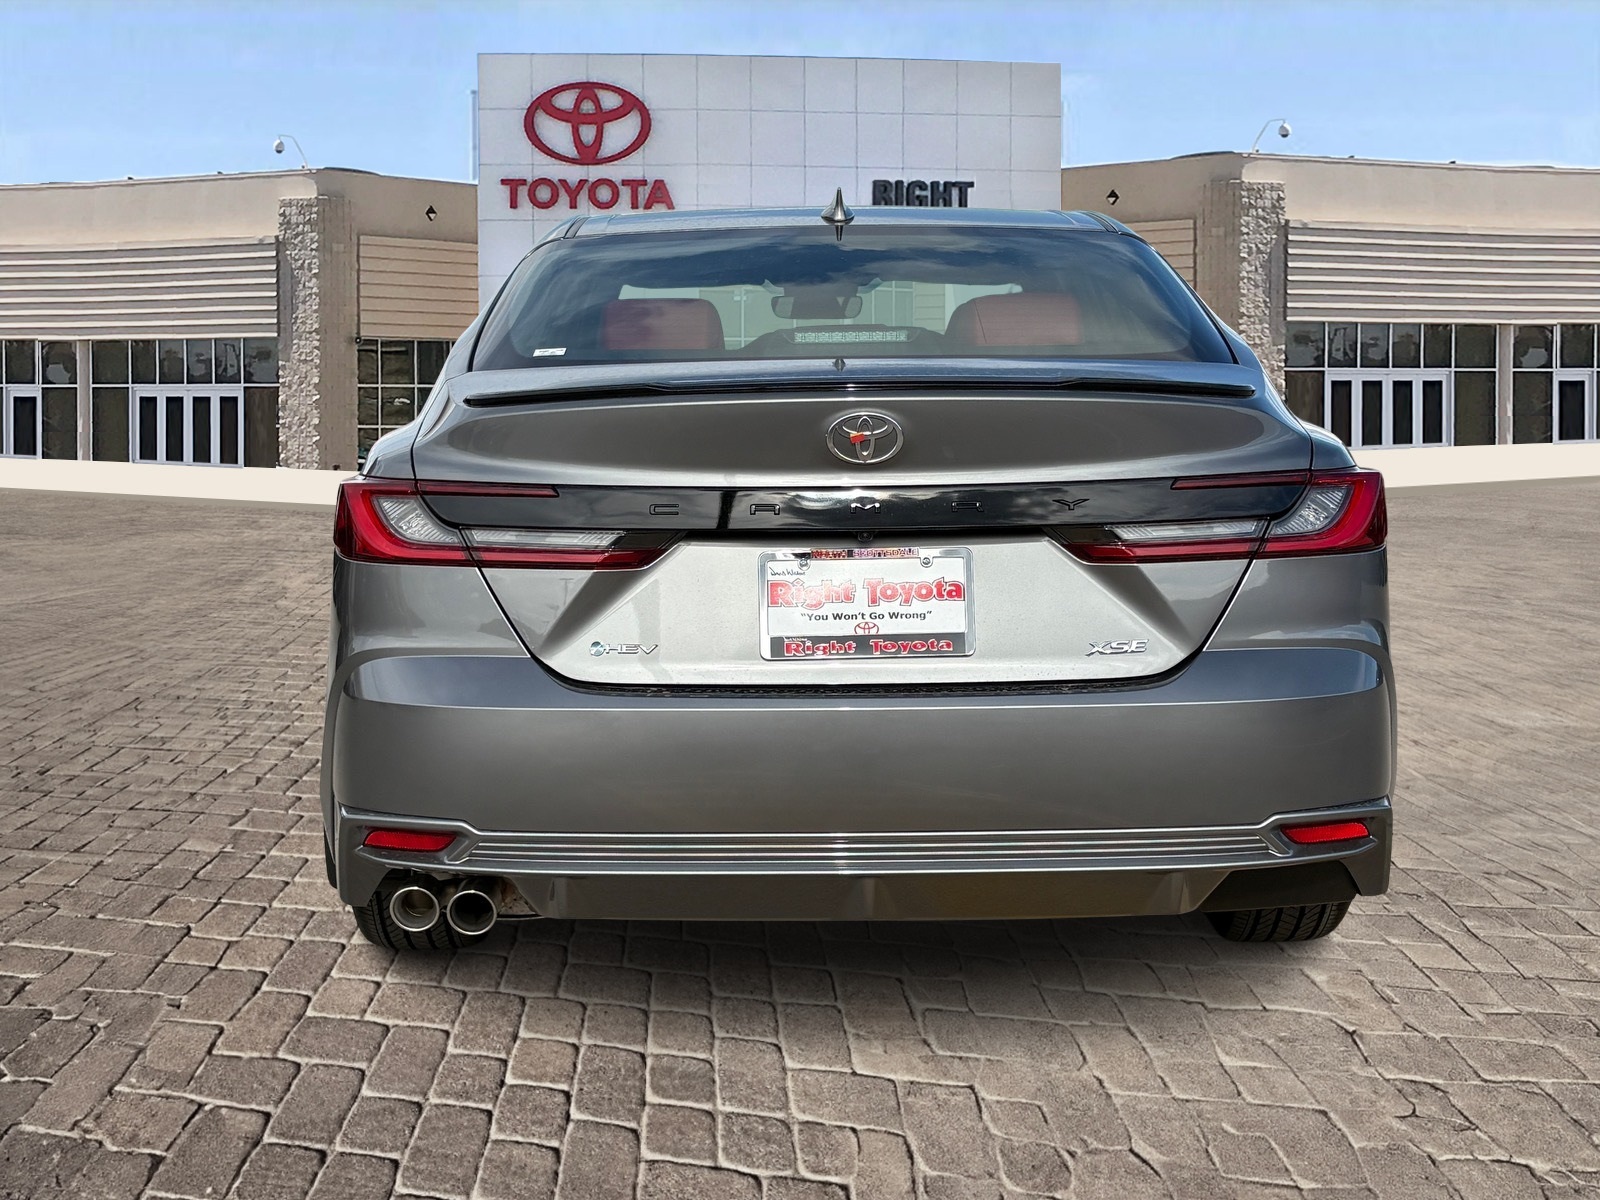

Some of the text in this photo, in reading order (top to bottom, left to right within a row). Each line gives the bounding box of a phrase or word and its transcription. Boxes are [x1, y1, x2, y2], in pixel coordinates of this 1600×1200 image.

[500, 178, 675, 210] TOYOTA
[872, 179, 975, 208] RIGHT
[649, 496, 1090, 516] CAMRY
[767, 577, 966, 610] Right Toyota
[832, 611, 866, 621] Won't
[869, 612, 885, 620] Go
[605, 643, 659, 655] HEV
[784, 639, 953, 656] Right Toyota
[1085, 639, 1149, 656] XSE
